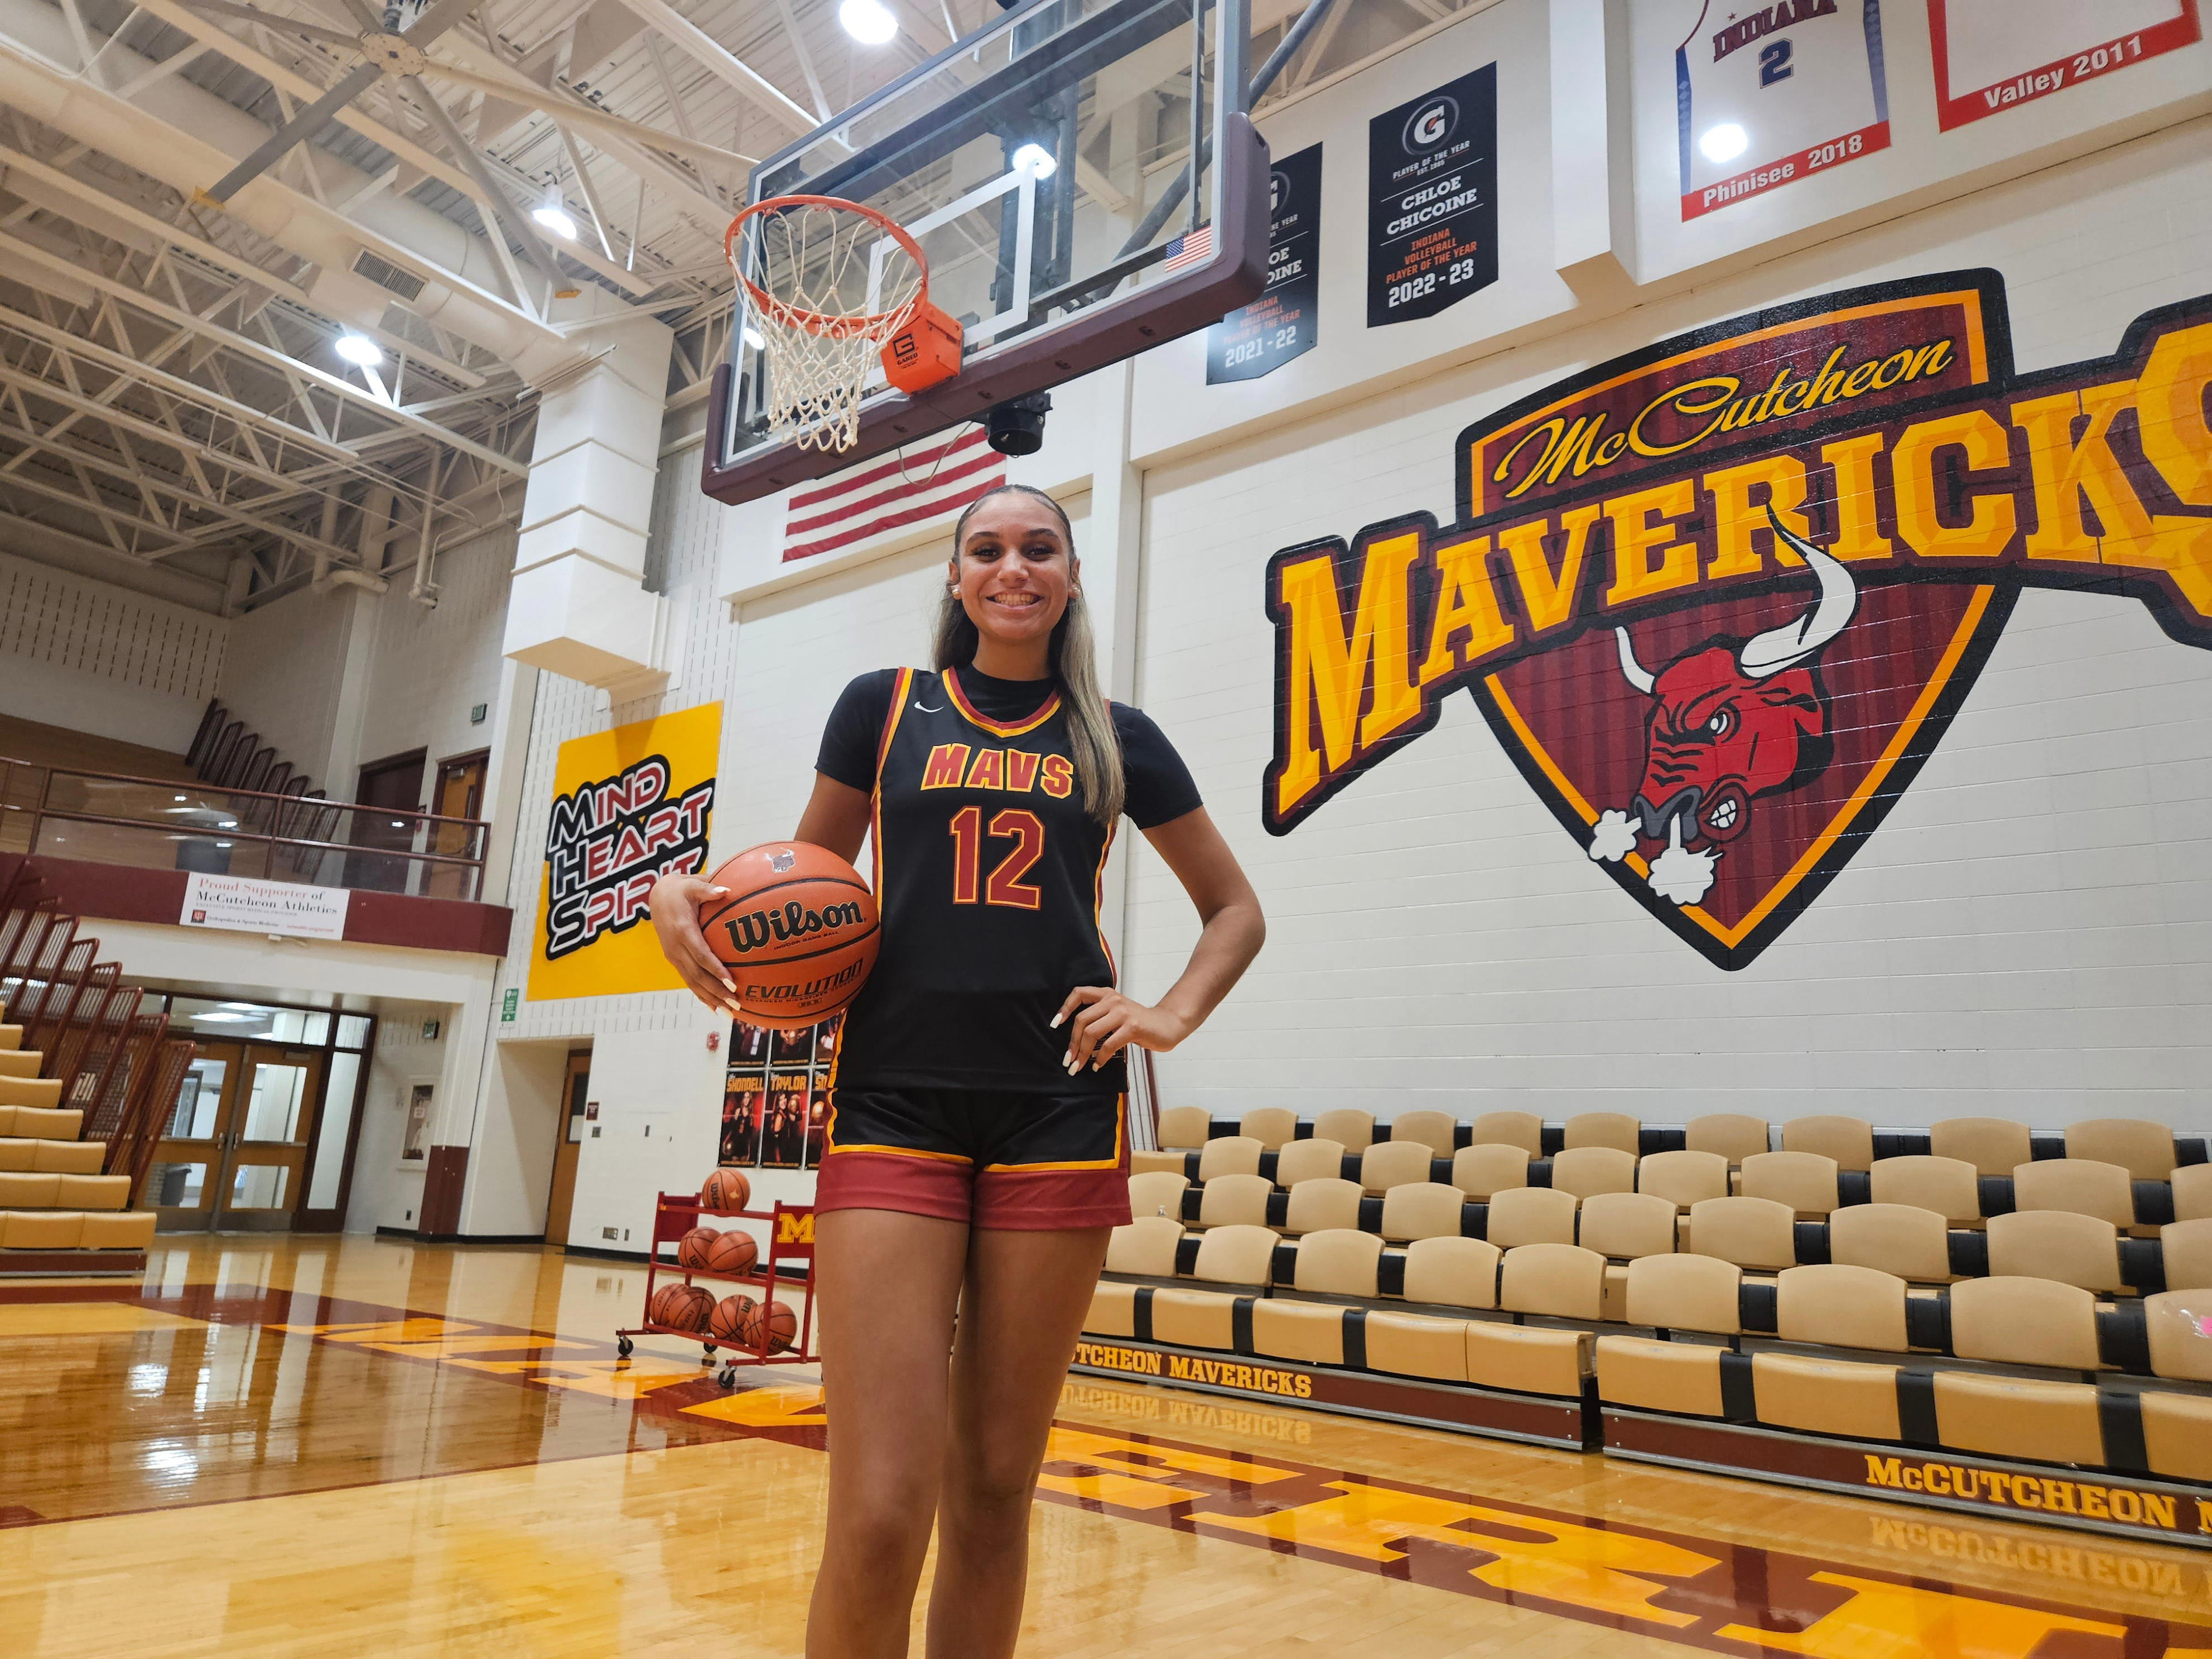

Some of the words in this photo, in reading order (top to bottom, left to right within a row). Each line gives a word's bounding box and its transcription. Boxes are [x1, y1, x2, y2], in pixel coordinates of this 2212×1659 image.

[1713, 0, 1838, 64] INDIANA
[1758, 37, 1794, 89] 2
[1983, 67, 2065, 109] Valley
[2073, 35, 2143, 78] 2011
[1392, 161, 1419, 180] PLAYER
[1422, 156, 1432, 166] OF
[1434, 149, 1449, 161] THE
[1450, 140, 1471, 154] YEAR
[1703, 162, 1794, 208] Phinisee
[1808, 134, 1863, 169] 2018
[1386, 188, 1477, 235] CHICOINE
[1401, 175, 1462, 210] CHLOE
[1281, 214, 1298, 226] YEAR
[1411, 228, 1450, 251] INDIANA
[1385, 264, 1418, 284] PLAYER
[1420, 260, 1432, 271] OF
[1434, 252, 1451, 266] THE
[1453, 241, 1477, 258] YEAR
[1404, 237, 1457, 265] VOLLEYBALL
[1389, 273, 1436, 308] 2022
[1449, 258, 1474, 285] 23
[1240, 305, 1283, 328] VOLLEYBALL
[1246, 295, 1279, 316] INDIANA
[1252, 323, 1262, 334] OF
[1264, 317, 1279, 330] THE
[1280, 309, 1300, 324] YEAR
[1225, 337, 1264, 368] 2021
[1275, 325, 1297, 349] 22
[1493, 339, 1954, 499] McCutcheon
[920, 742, 1074, 799] MAVS
[548, 762, 666, 853] MIND
[553, 787, 714, 900] HEART
[949, 805, 1046, 911] 12
[197, 891, 277, 908] McCutcheon
[282, 900, 338, 914] Athletics
[200, 877, 239, 891] Proud
[244, 882, 309, 898] Supporter
[311, 891, 325, 900] of
[725, 900, 864, 954] Wilson
[774, 939, 801, 950] INDOOR
[802, 934, 822, 943] GAME
[745, 957, 864, 999] EVOLUTION
[770, 1076, 807, 1092] TAYLOR
[777, 1213, 816, 1243] M
[1071, 1343, 1162, 1376] TCHEON
[1169, 1355, 1312, 1398] MAVERICKS
[1864, 1454, 2176, 1529] McCUTCHEON
